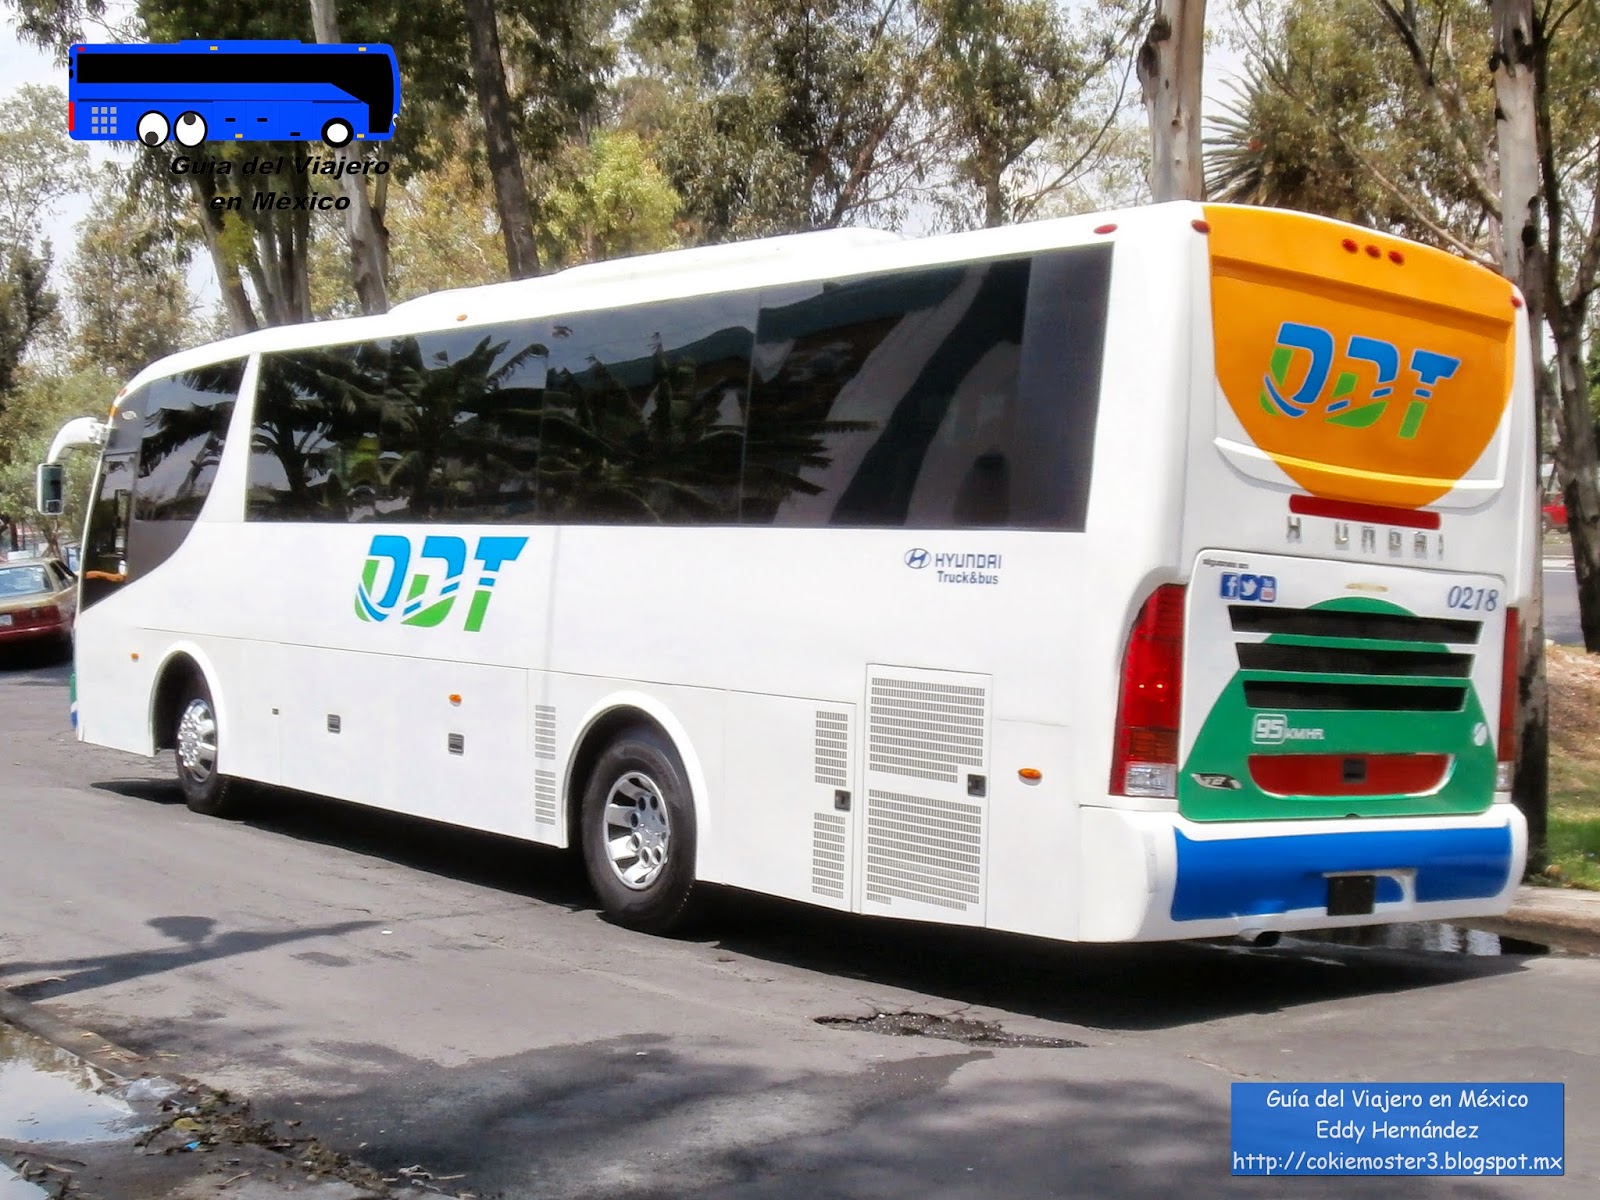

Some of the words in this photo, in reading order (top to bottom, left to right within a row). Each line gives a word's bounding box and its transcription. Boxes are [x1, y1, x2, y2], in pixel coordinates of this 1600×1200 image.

[935, 552, 1002, 569] HYUNDAI
[1447, 585, 1499, 612] 0218
[1255, 719, 1285, 739] 95
